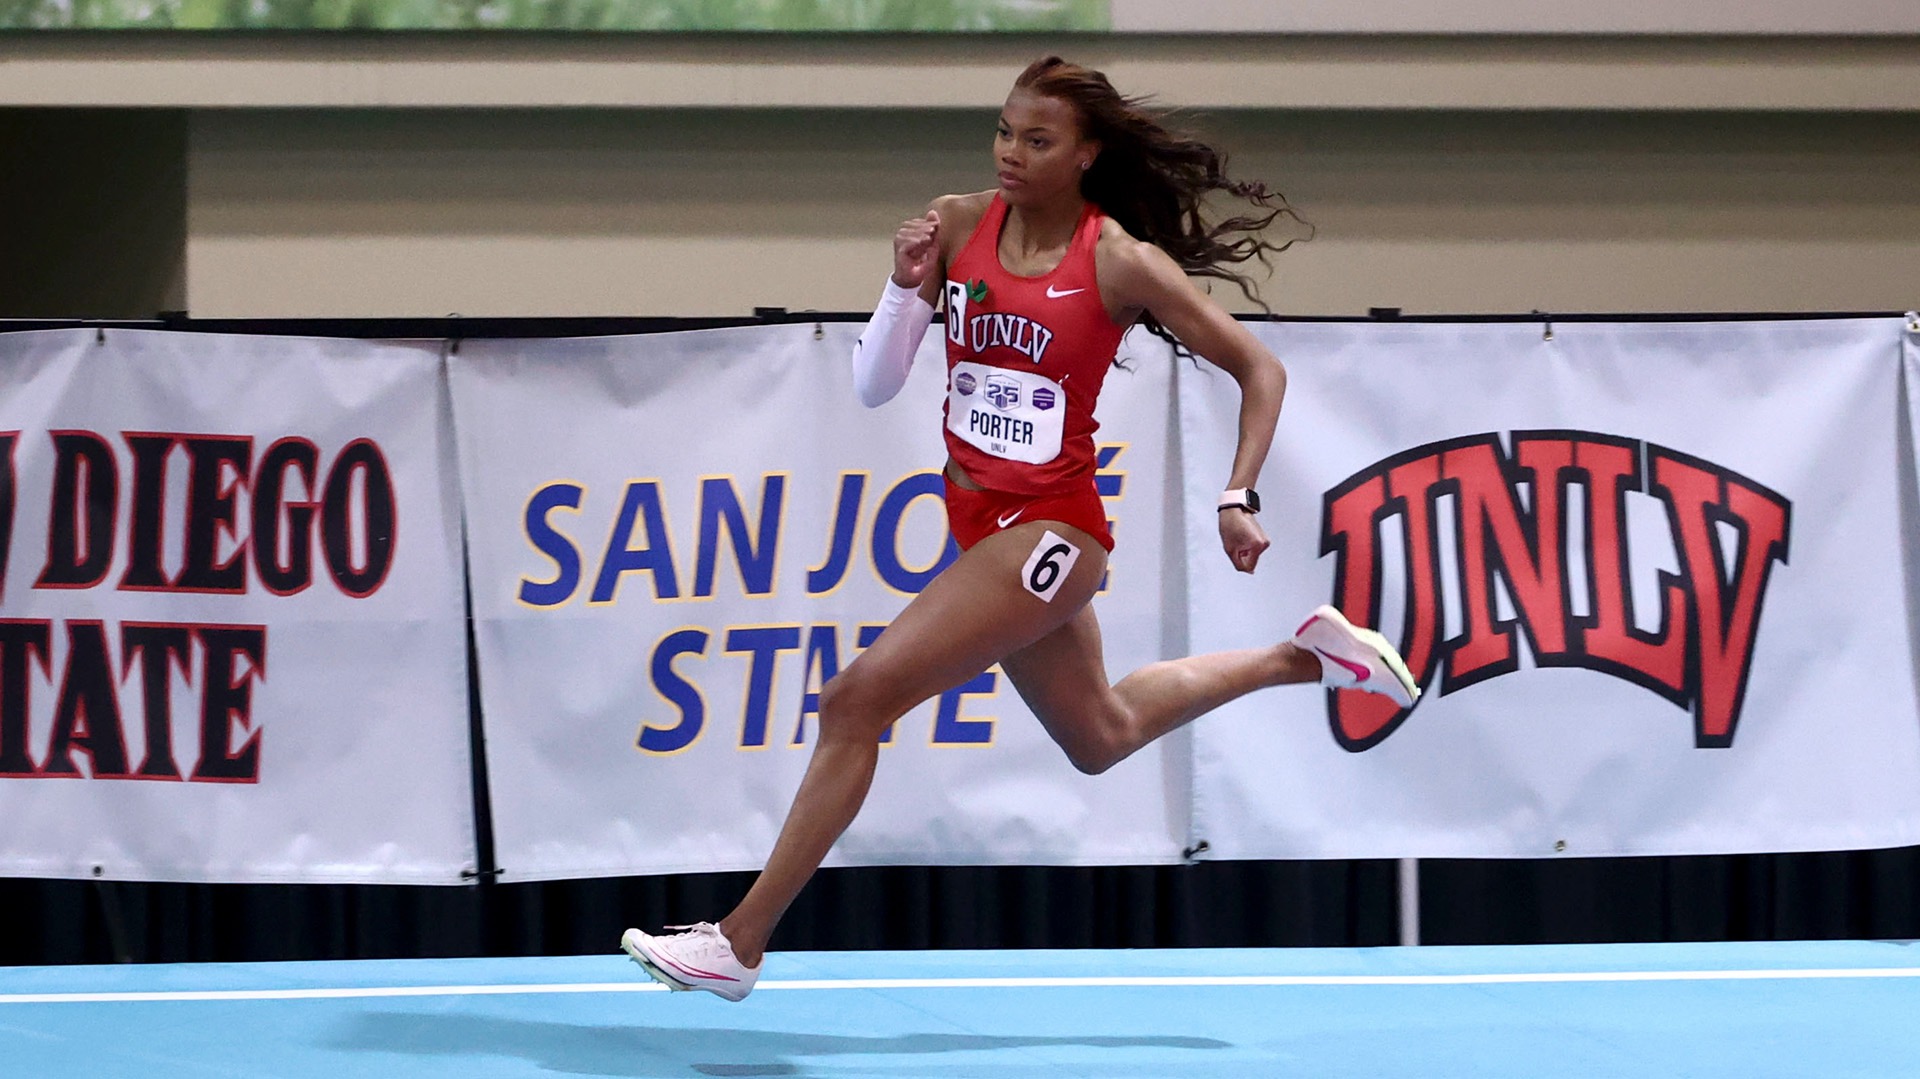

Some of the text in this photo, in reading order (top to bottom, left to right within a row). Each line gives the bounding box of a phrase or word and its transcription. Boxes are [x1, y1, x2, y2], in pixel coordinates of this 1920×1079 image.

[950, 286, 960, 340] 6
[970, 312, 1053, 364] UNLV
[986, 383, 1019, 403] 25
[970, 409, 1033, 445] PORTER
[991, 442, 1007, 454] UNLV
[32, 429, 397, 599] DIEGO
[517, 471, 789, 610] SAN
[1030, 543, 1071, 593] 6
[1319, 428, 1793, 754] UNLV
[0, 618, 268, 784] TATE
